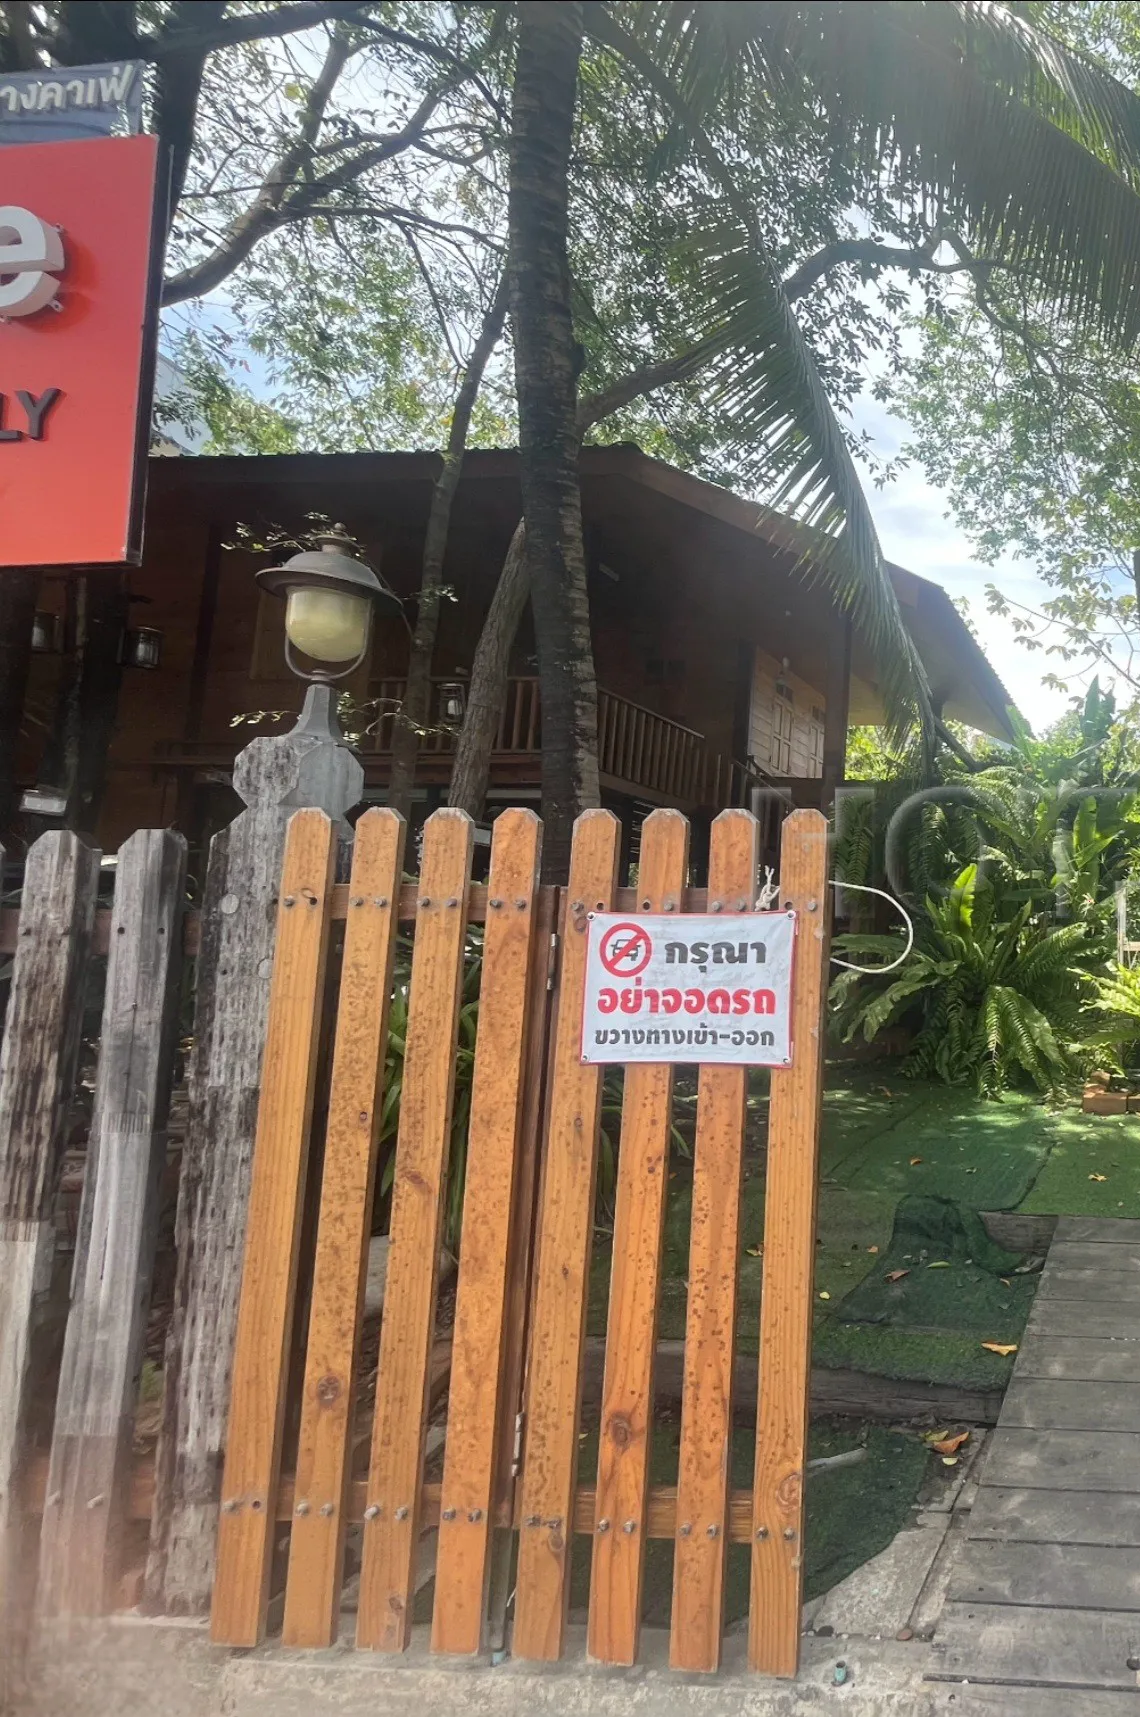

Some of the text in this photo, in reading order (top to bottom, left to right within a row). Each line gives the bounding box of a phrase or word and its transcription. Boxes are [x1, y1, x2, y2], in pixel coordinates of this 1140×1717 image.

[664, 941, 767, 973] กรุณา
[597, 977, 777, 1015] อย่าจอดรถ
[595, 1023, 775, 1046] ขวางทางเข้า-ออก
